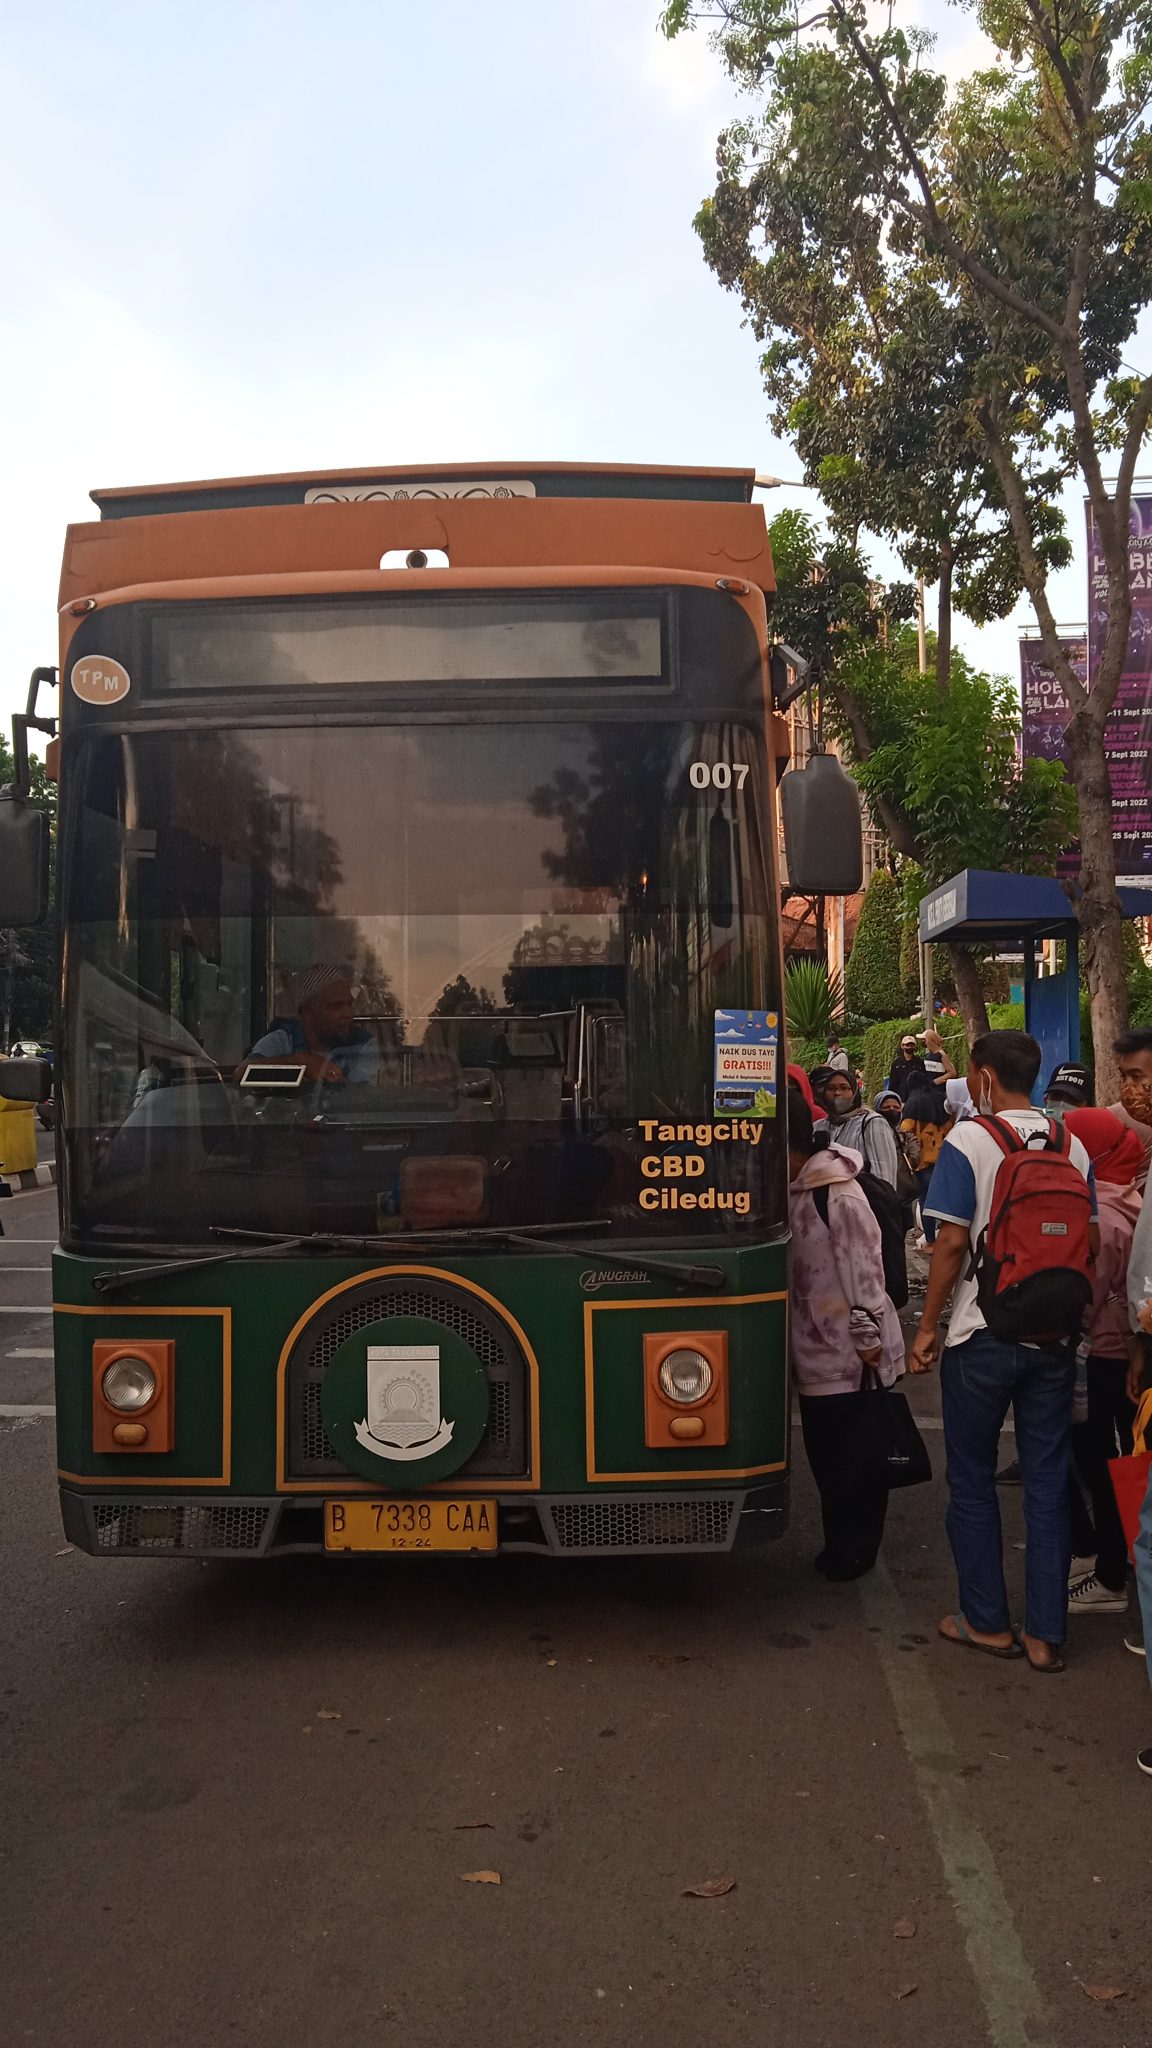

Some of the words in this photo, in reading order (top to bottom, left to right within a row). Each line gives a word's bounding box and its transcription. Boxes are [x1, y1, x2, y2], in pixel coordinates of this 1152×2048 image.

[80, 669, 119, 691] TPM
[1123, 708, 1140, 717] Sept
[1111, 751, 1128, 760] Sept
[1129, 750, 1148, 758] 2022
[689, 762, 750, 790] 007
[1111, 799, 1128, 808] Sept
[1129, 798, 1148, 806] 2022
[1123, 831, 1140, 840] Sept
[741, 1048, 757, 1056] BUS
[758, 1049, 775, 1057] TAYO
[723, 1060, 772, 1071] GRATIS!!!
[1068, 1076, 1078, 1084] DO
[638, 1119, 764, 1147] Tangcity
[640, 1155, 705, 1178] CBD
[638, 1187, 750, 1214] Ciledug
[580, 1270, 651, 1291] ANUGRAH
[332, 1504, 345, 1532] B
[370, 1504, 432, 1532] 7338
[446, 1503, 490, 1532] CAA
